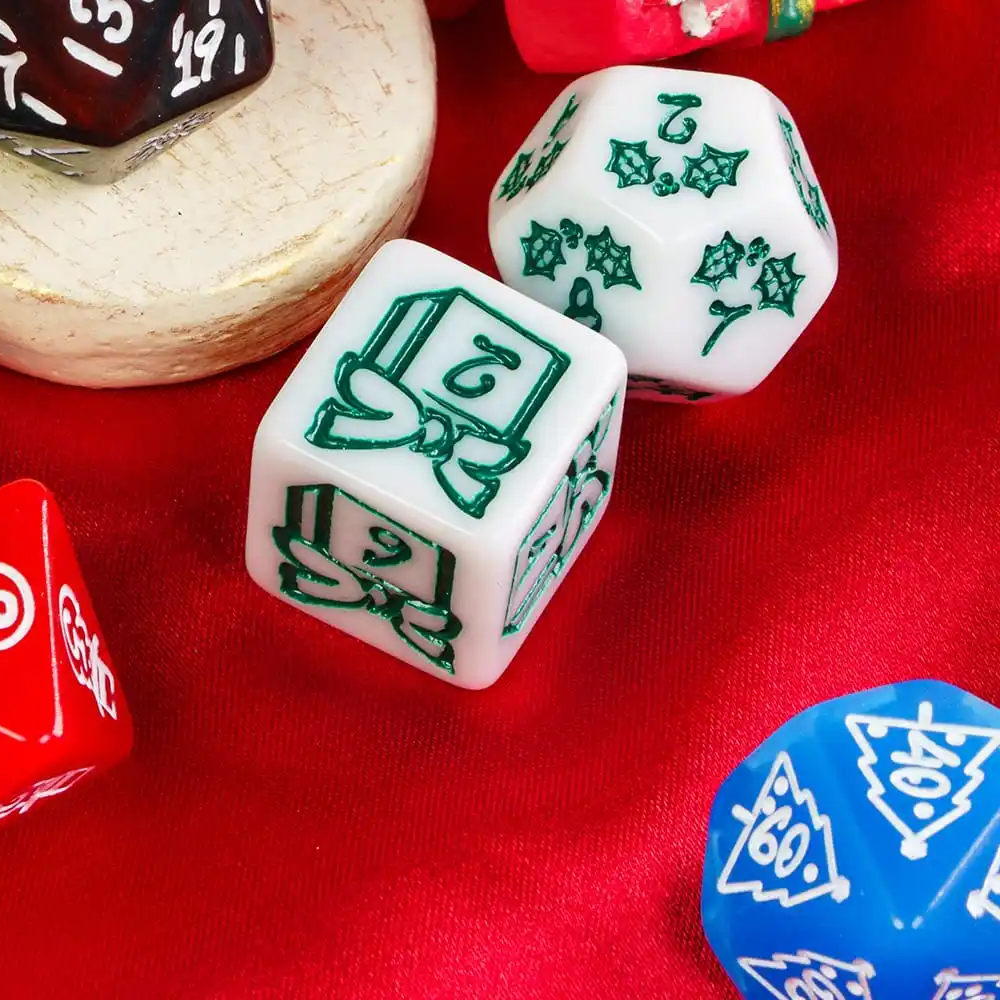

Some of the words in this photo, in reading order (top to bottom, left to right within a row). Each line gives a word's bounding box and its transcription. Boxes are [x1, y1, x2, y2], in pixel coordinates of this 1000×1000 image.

[171, 17, 226, 99] 19
[656, 92, 703, 145] 2
[699, 299, 754, 357] 7
[442, 333, 523, 400] 2
[889, 728, 961, 799] 40
[748, 805, 810, 878] 60
